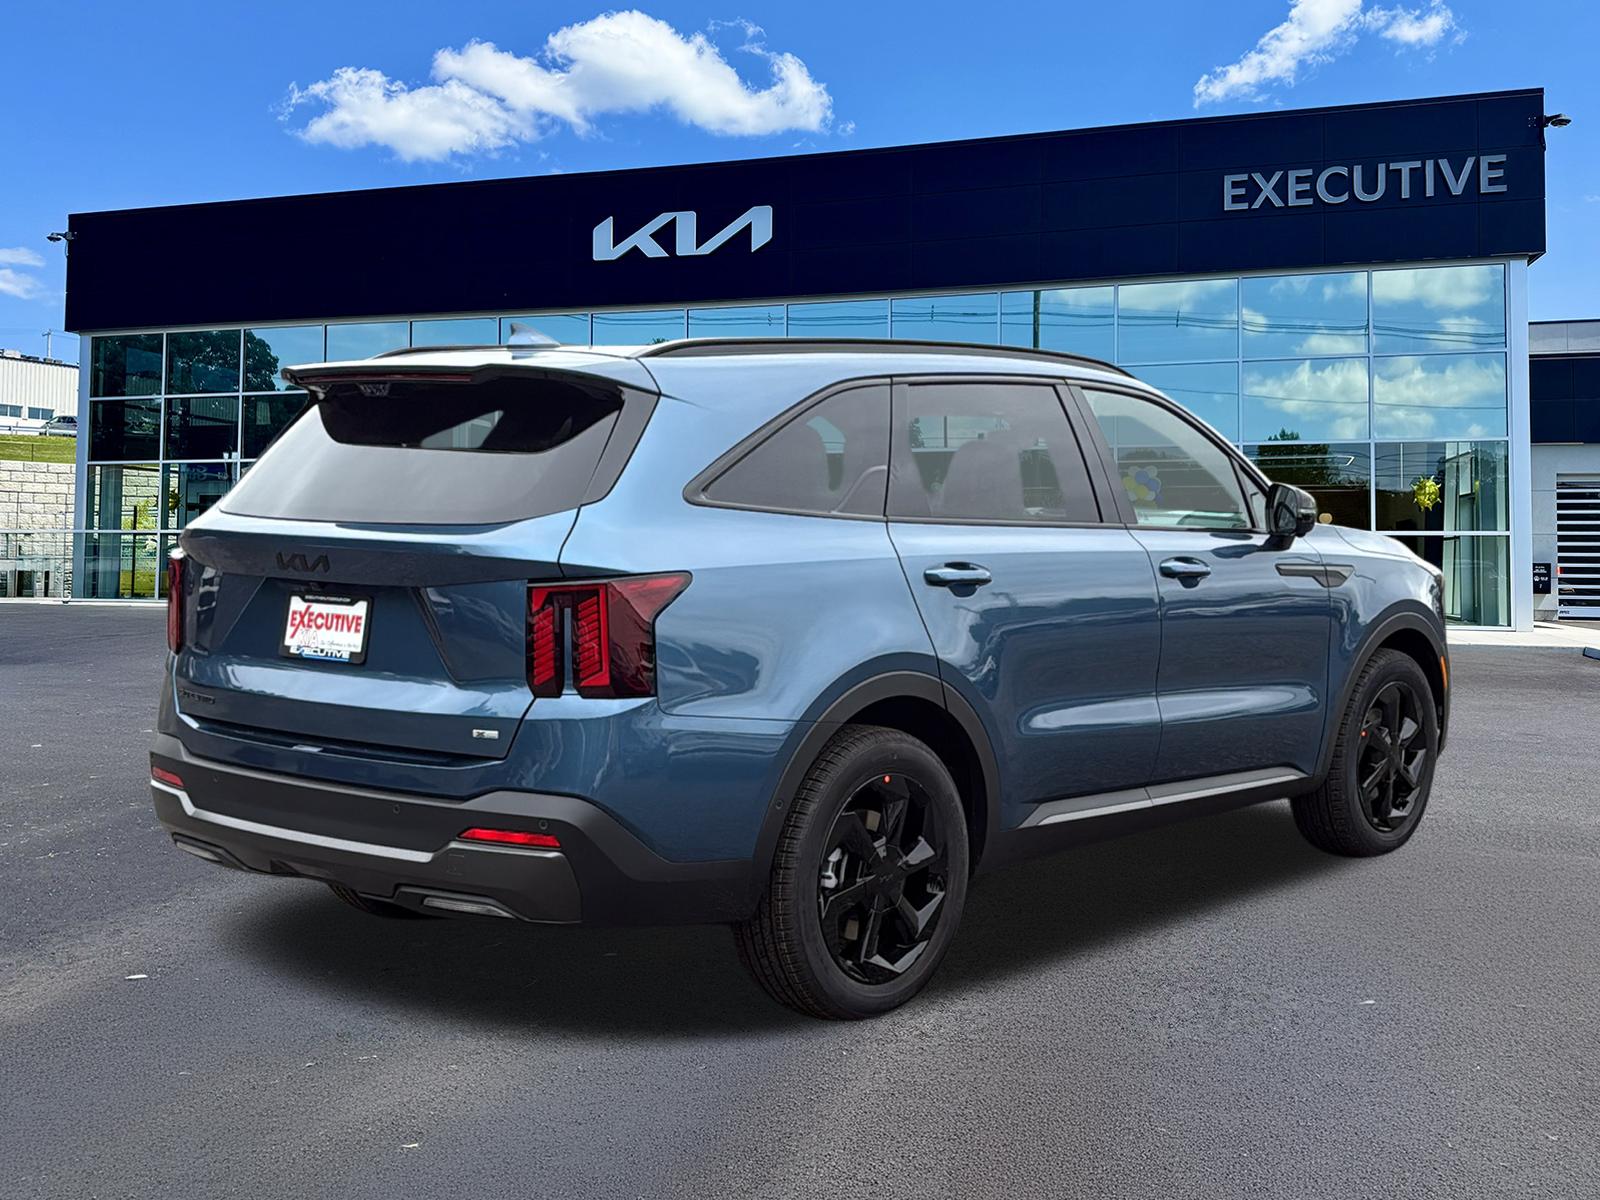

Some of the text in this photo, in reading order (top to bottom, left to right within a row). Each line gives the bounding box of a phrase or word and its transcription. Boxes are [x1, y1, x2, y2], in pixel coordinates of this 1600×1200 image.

[1223, 154, 1508, 211] EXECUTIVE
[592, 205, 773, 261] KIA
[276, 551, 330, 574] KIA
[289, 604, 363, 640] EXECUTIVE
